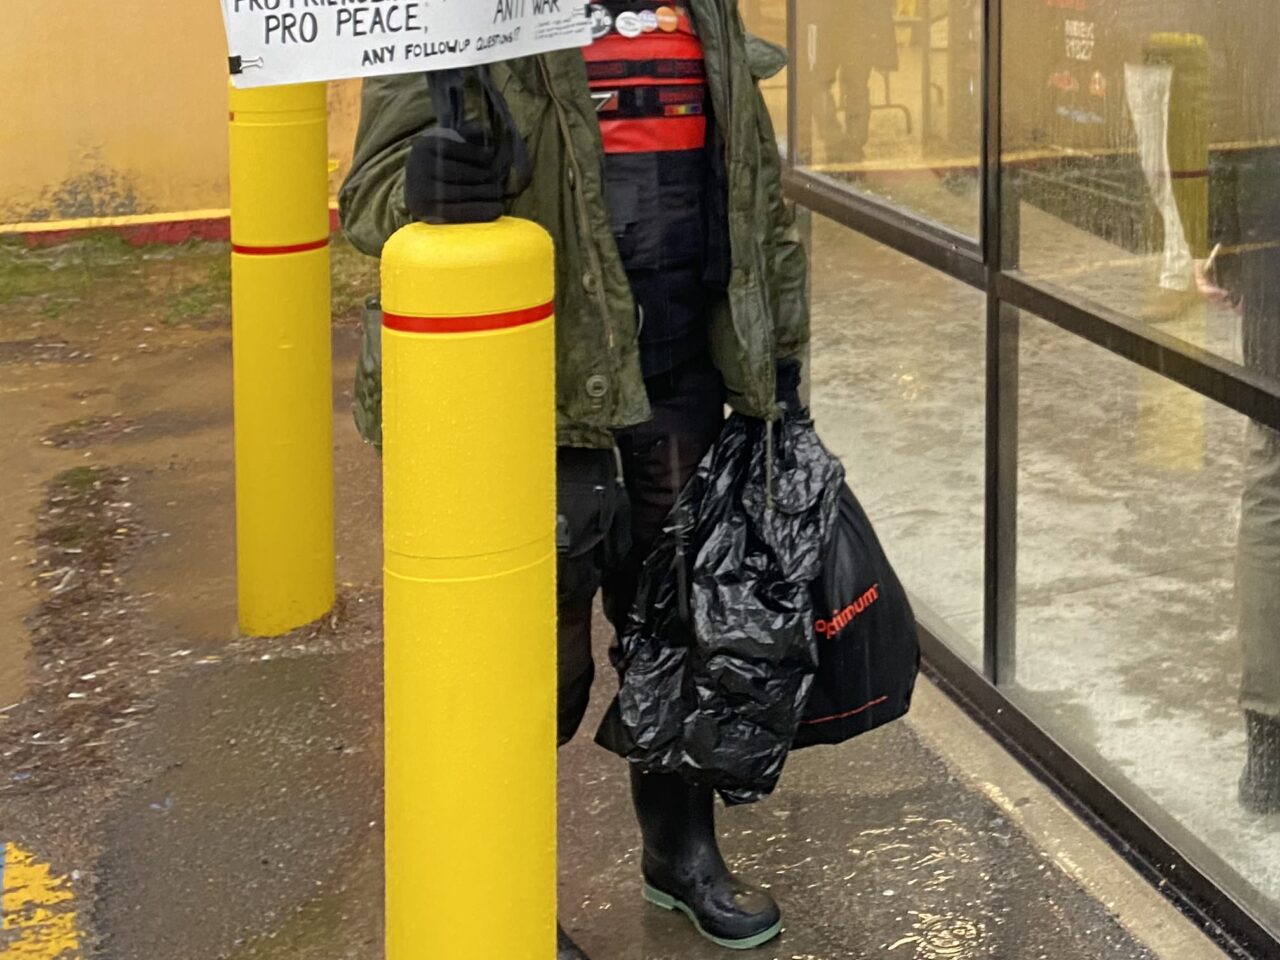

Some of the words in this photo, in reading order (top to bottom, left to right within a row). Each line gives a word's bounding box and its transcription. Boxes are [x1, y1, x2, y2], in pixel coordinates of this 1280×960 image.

[264, 12, 319, 45] PRO
[336, 3, 429, 37] PEACE,
[361, 45, 397, 67] ANY
